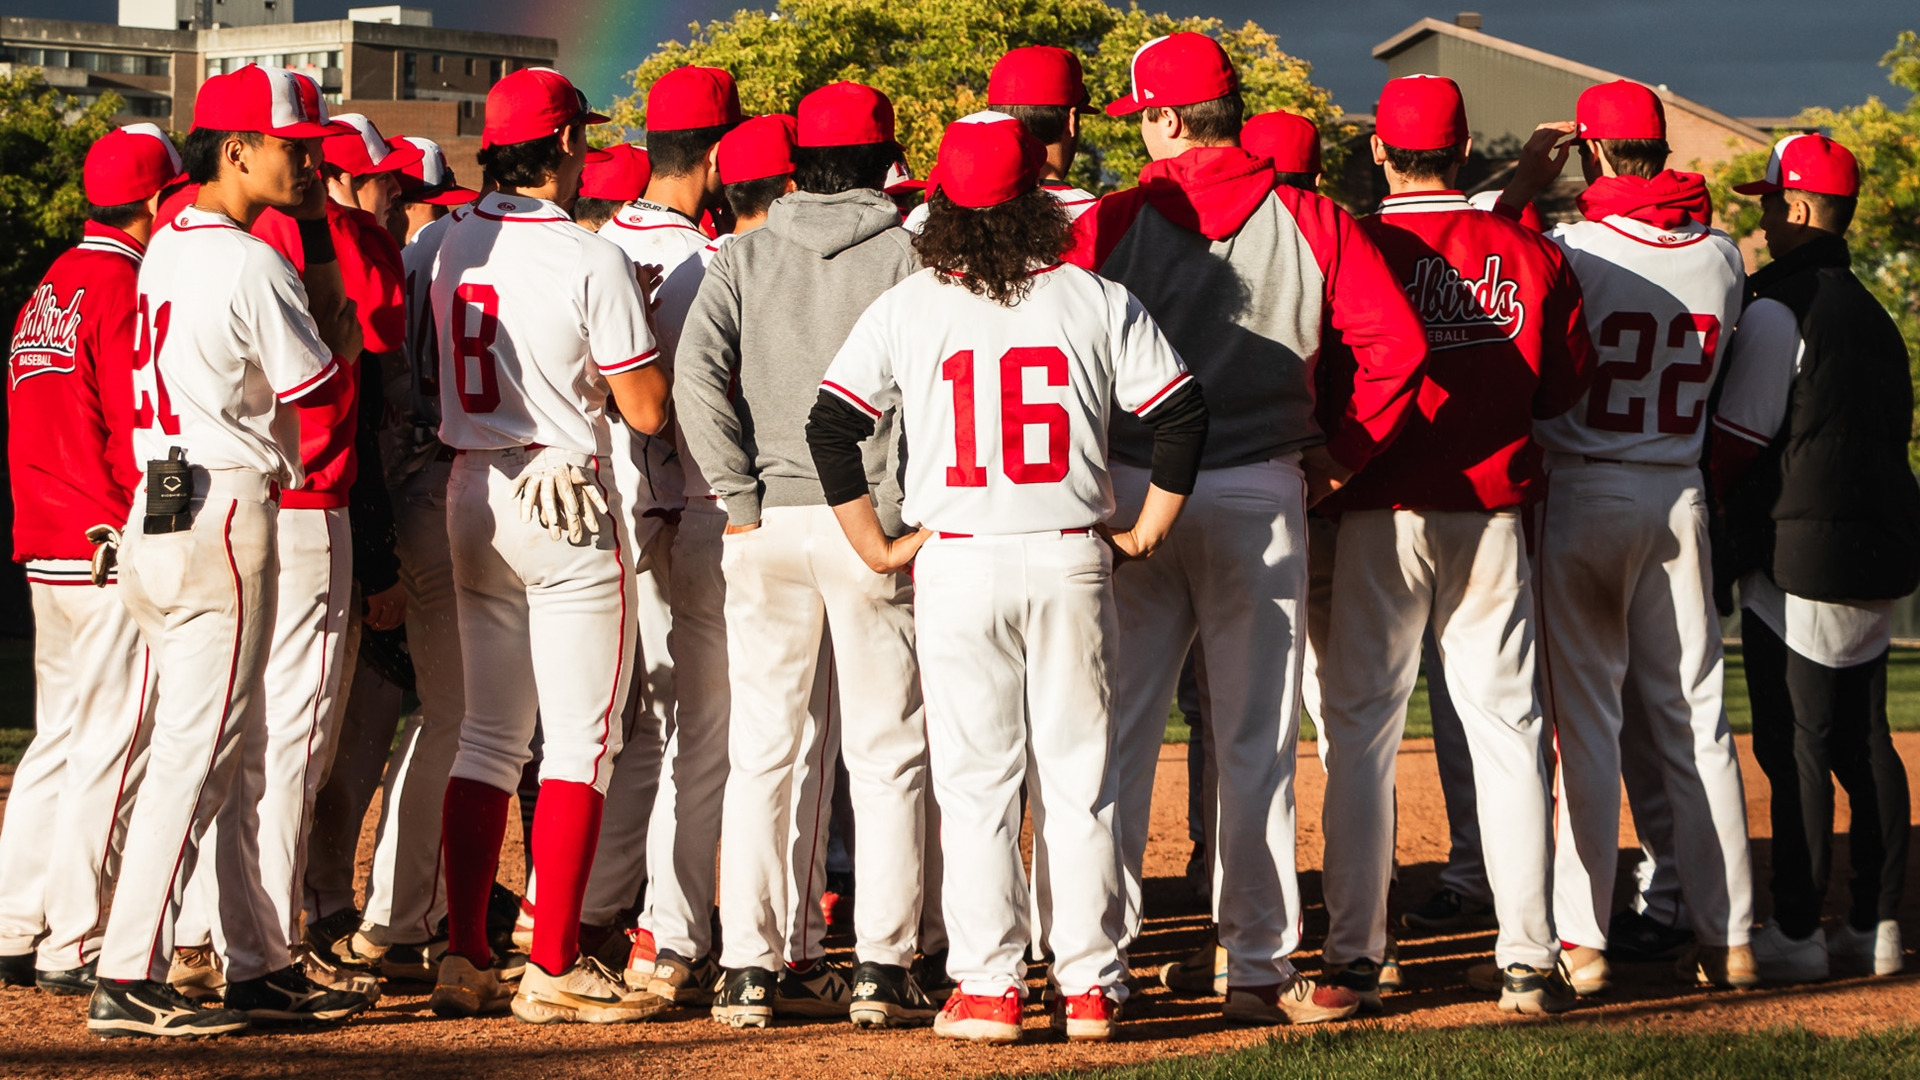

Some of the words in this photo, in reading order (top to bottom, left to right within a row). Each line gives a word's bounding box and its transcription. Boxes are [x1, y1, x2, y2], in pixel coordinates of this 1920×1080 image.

[1404, 255, 1520, 322] dbirds
[452, 283, 501, 413] 8
[1427, 329, 1469, 342] EBALL
[19, 354, 52, 366] BASEBALL
[1586, 311, 1721, 435] 22
[942, 346, 1070, 487] 16
[740, 985, 766, 1000] NB
[853, 982, 877, 996] NB
